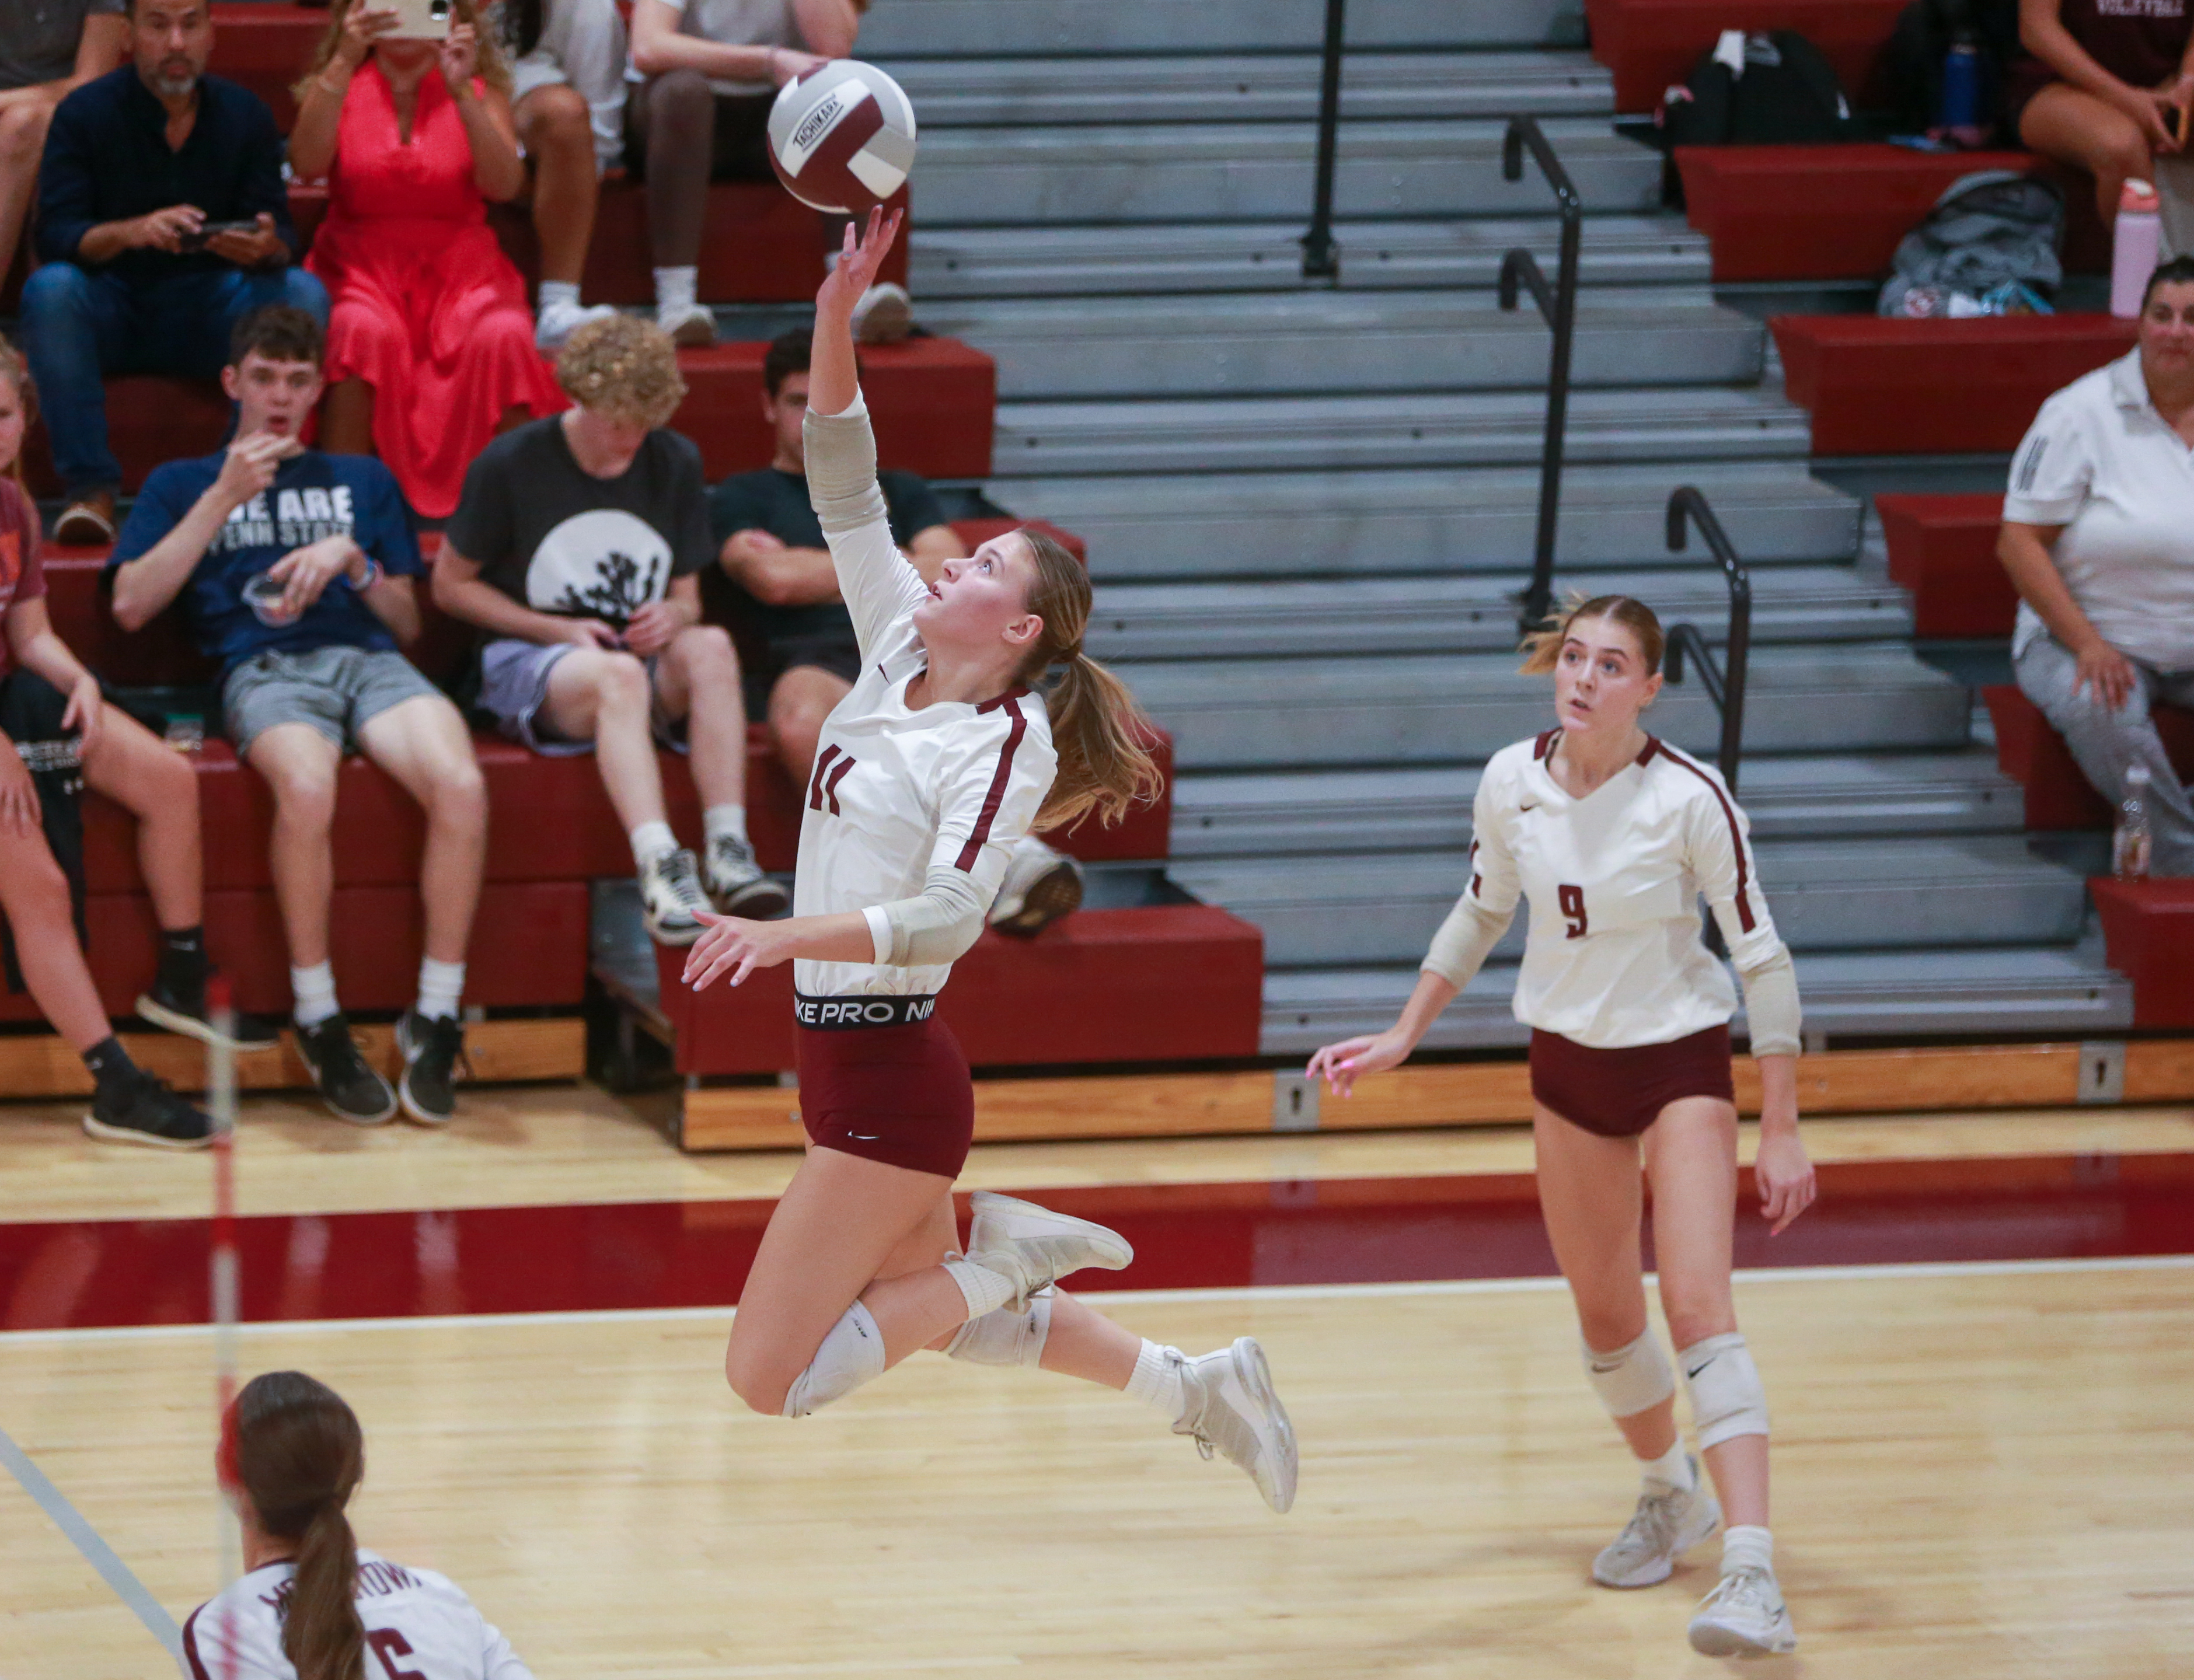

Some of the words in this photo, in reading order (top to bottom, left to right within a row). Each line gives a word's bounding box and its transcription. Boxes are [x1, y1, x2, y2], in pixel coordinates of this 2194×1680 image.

[793, 100, 840, 147] TACHIKARA
[277, 484, 355, 523] ARE
[810, 743, 857, 818] 11
[1558, 884, 1588, 939] 9
[820, 1003, 894, 1024] PRO
